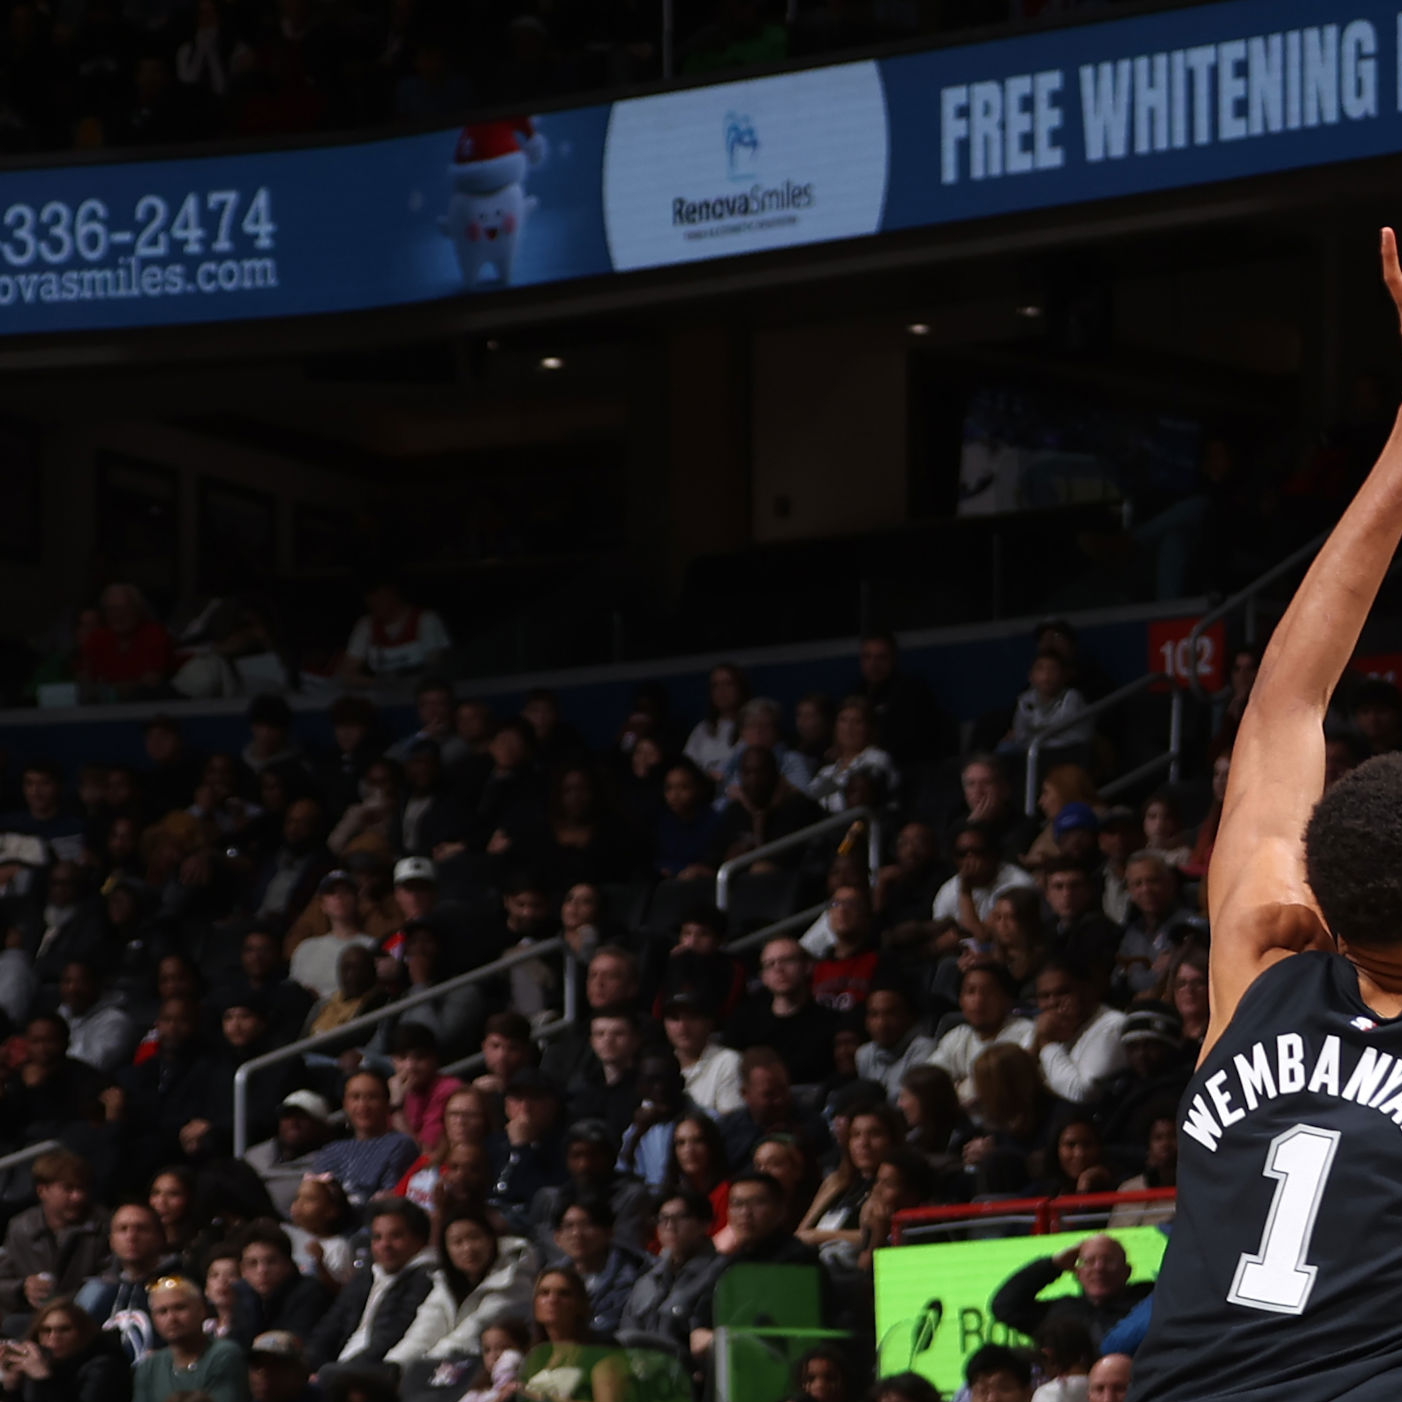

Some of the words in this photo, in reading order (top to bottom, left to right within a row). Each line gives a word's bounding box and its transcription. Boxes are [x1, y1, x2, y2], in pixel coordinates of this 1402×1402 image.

[941, 70, 1065, 184] FREE
[1080, 20, 1378, 162] WHITENING
[1, 186, 277, 266] 336-2474
[673, 179, 814, 226] RenovaSmiles
[1226, 1123, 1341, 1315] 1
